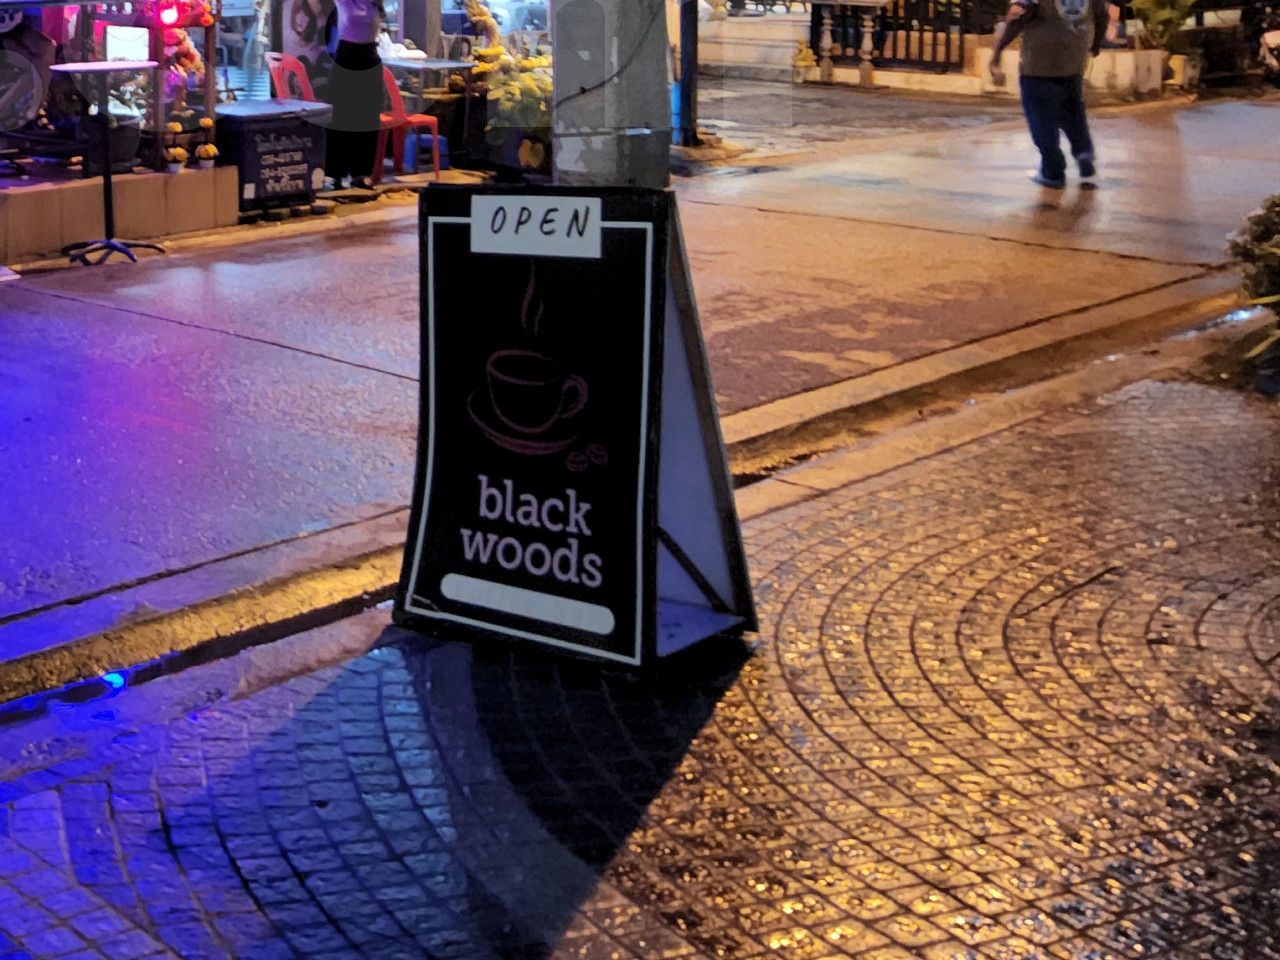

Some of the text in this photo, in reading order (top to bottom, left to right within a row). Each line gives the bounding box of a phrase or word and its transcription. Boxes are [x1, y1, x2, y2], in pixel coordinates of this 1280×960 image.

[490, 206, 590, 238] OPEN
[477, 474, 593, 536] black
[459, 527, 603, 588] woods
